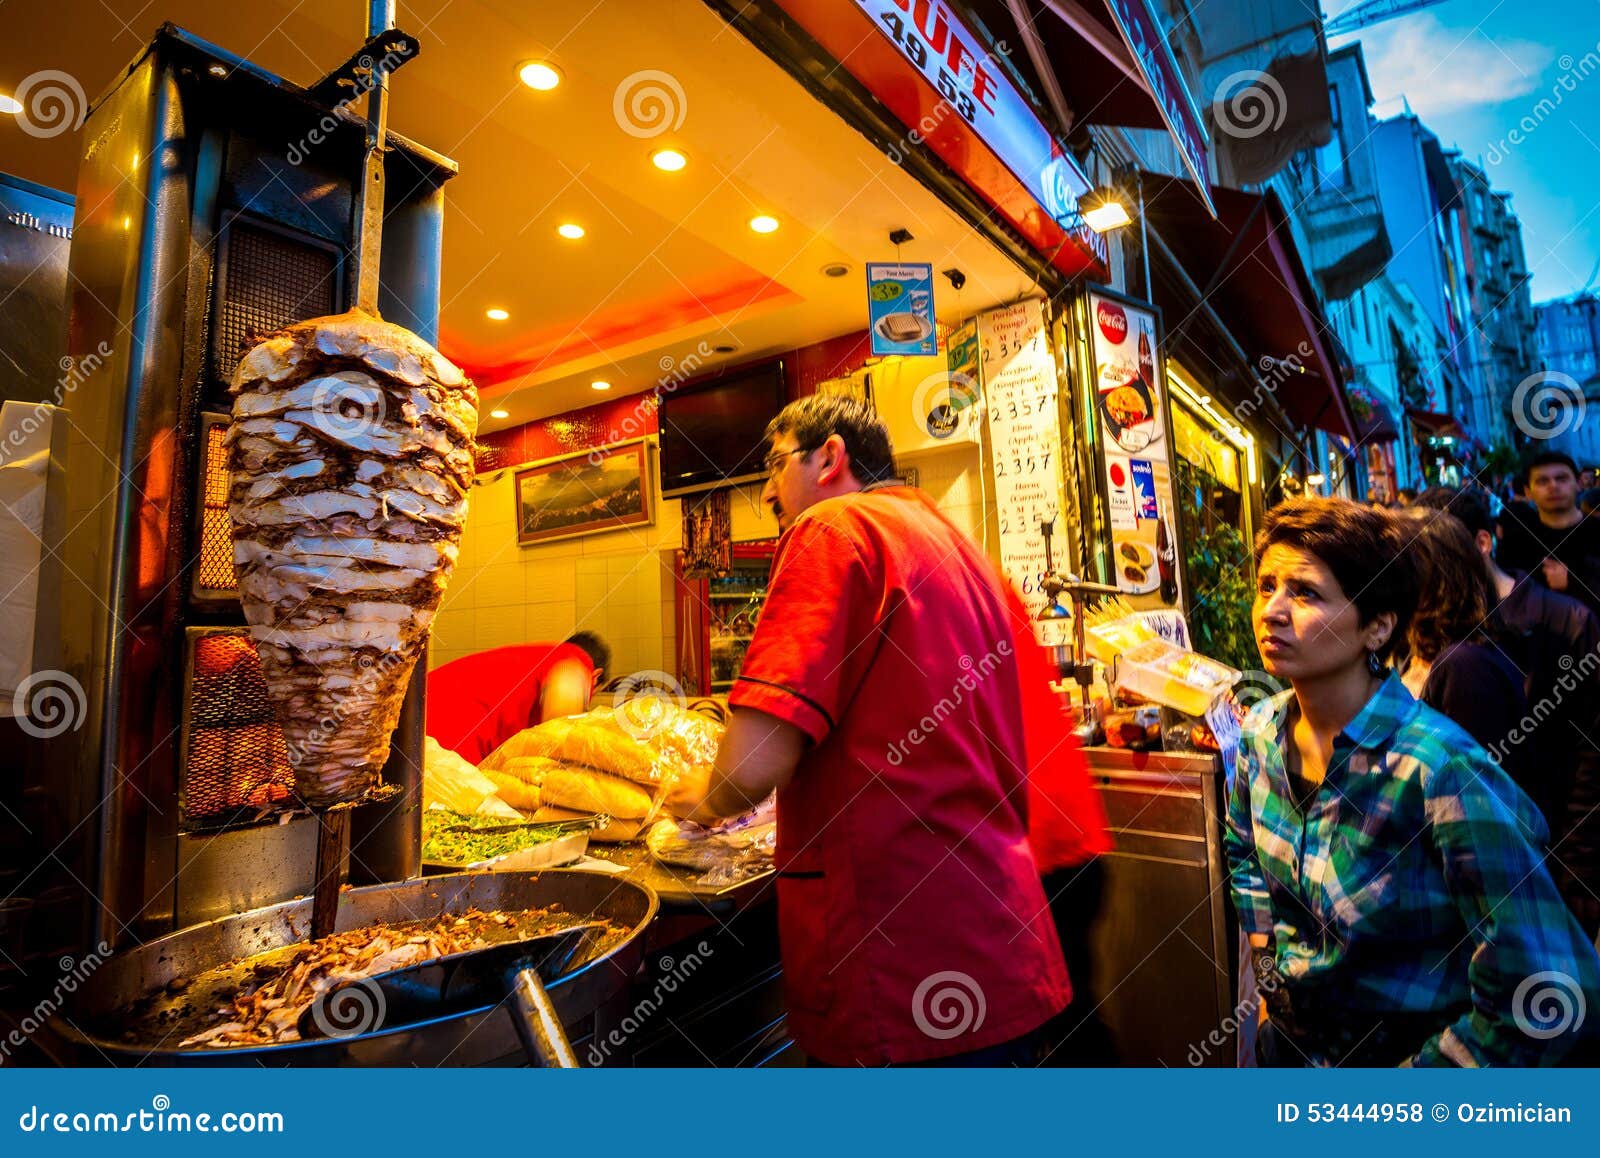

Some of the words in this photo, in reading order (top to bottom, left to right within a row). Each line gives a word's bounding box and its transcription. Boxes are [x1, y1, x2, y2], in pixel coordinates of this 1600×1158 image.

[881, 11, 927, 70] 49
[938, 66, 976, 123] 53
[1000, 343, 1008, 359] 3
[991, 407, 1001, 423] 2
[1008, 401, 1018, 420] 3
[1021, 400, 1032, 416] 5
[1036, 395, 1047, 413] 7
[996, 462, 1008, 479] 2
[1013, 458, 1022, 475] 3
[1027, 456, 1036, 474] 5
[1040, 453, 1051, 471] 7
[1001, 519, 1012, 535] 2
[1017, 516, 1027, 533] 3
[1023, 575, 1032, 595] 6
